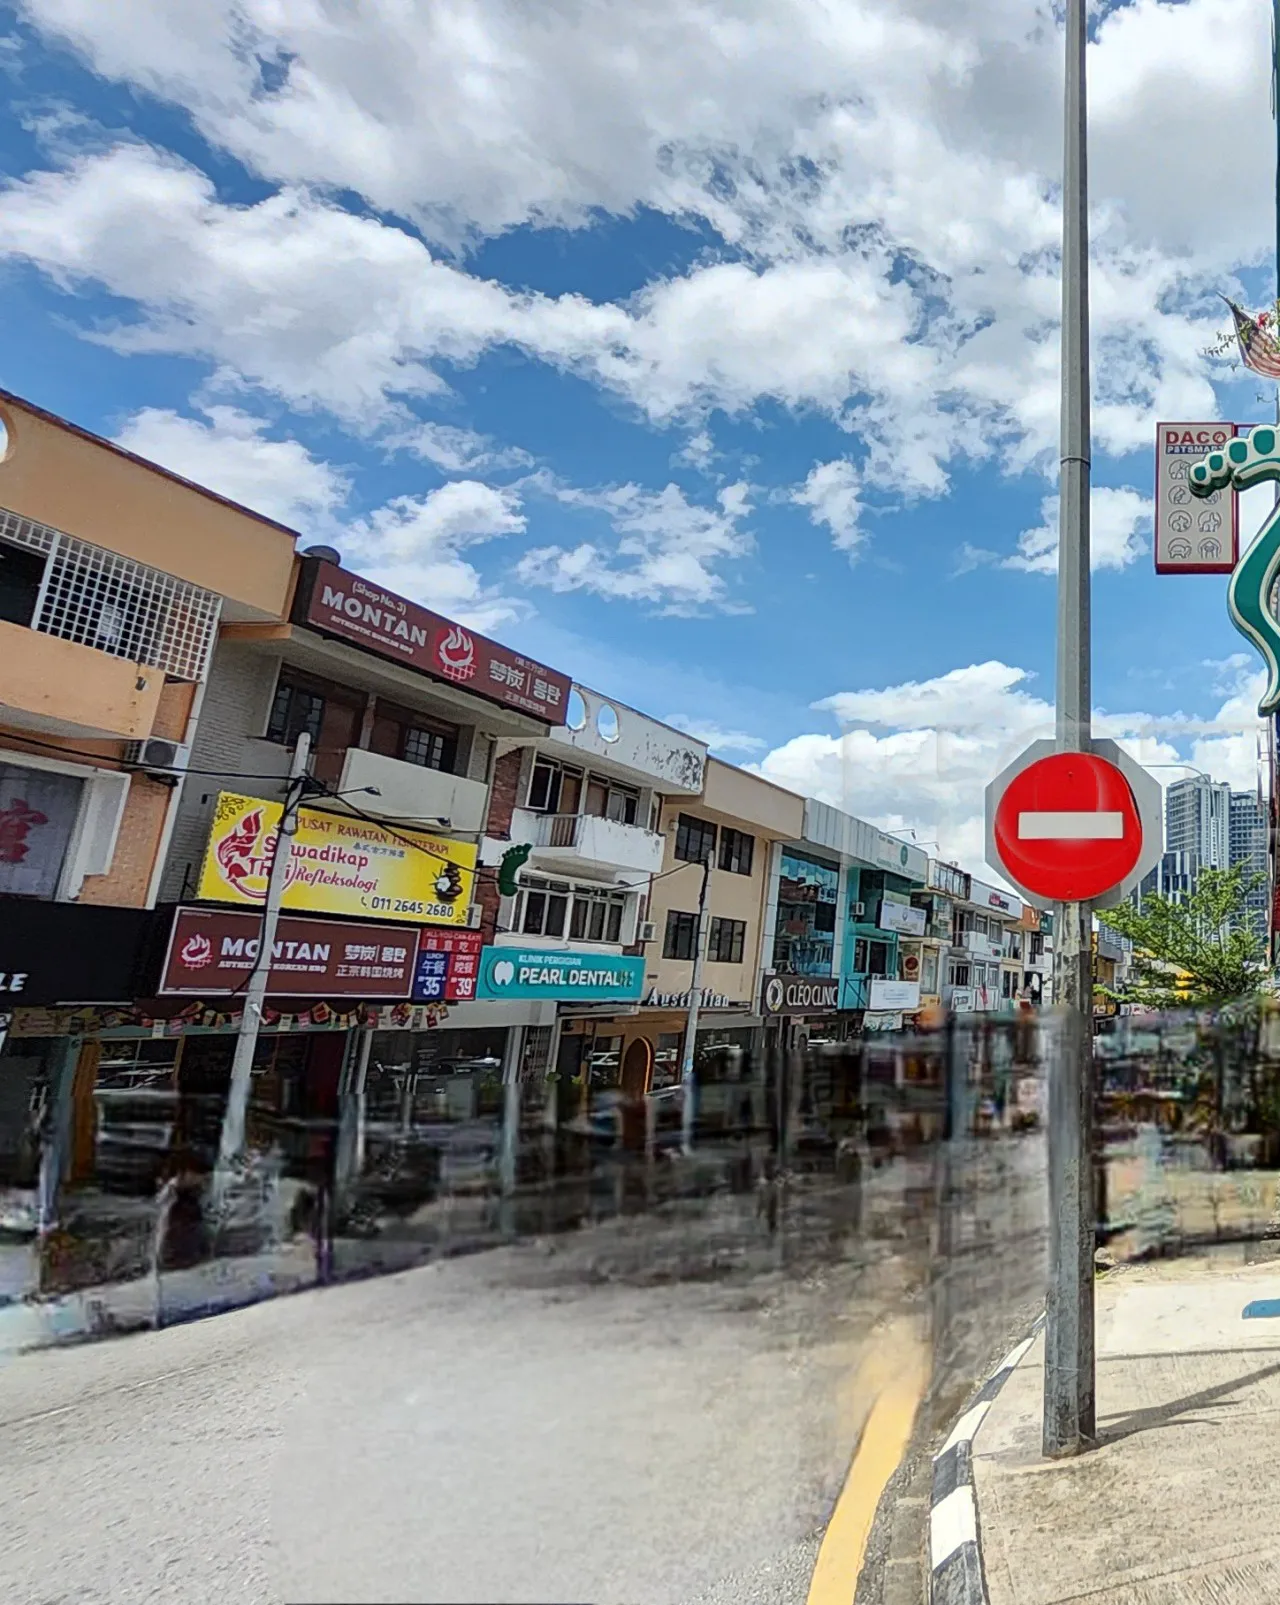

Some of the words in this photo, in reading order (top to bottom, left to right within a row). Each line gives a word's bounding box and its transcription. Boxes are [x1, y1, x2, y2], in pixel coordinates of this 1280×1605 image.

[1165, 430, 1227, 445] DACO
[321, 585, 428, 647] MONTAN
[263, 835, 369, 872] Swadikap
[248, 857, 292, 880] Thi
[296, 865, 379, 893] Refleksologi
[371, 896, 392, 910] 011
[394, 899, 424, 914] 2645
[427, 903, 454, 918] 2680
[220, 936, 331, 961] MONTAN
[423, 976, 441, 996] 35
[456, 977, 473, 996] 39
[519, 967, 568, 985] PEARL
[568, 970, 621, 986] DENTAL
[647, 986, 730, 1008] Austrlian
